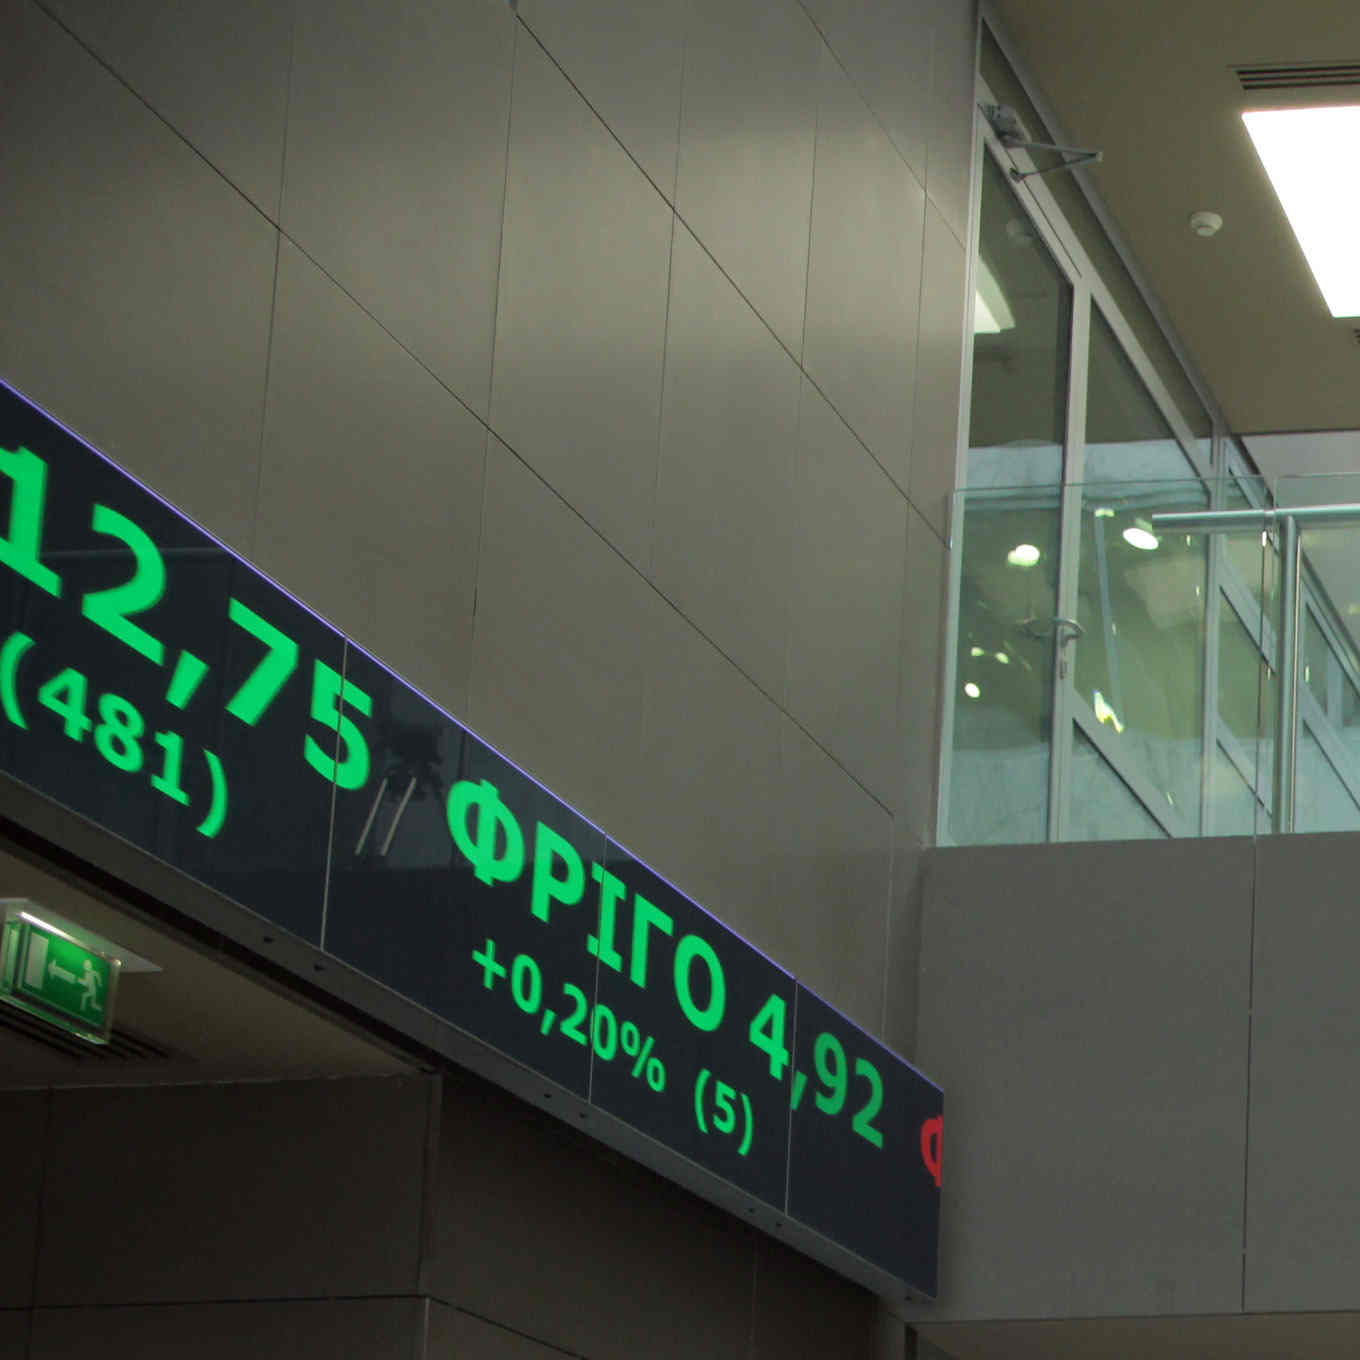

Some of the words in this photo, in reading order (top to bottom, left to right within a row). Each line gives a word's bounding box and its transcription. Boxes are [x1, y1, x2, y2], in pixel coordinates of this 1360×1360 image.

[0, 445, 374, 792] 12,75
[446, 778, 727, 1033] ΦΡΙΓΟ
[748, 993, 885, 1149] 4,92
[0, 630, 230, 839] (481)
[470, 938, 668, 1093] +0,20%
[694, 1067, 755, 1157] (5)
